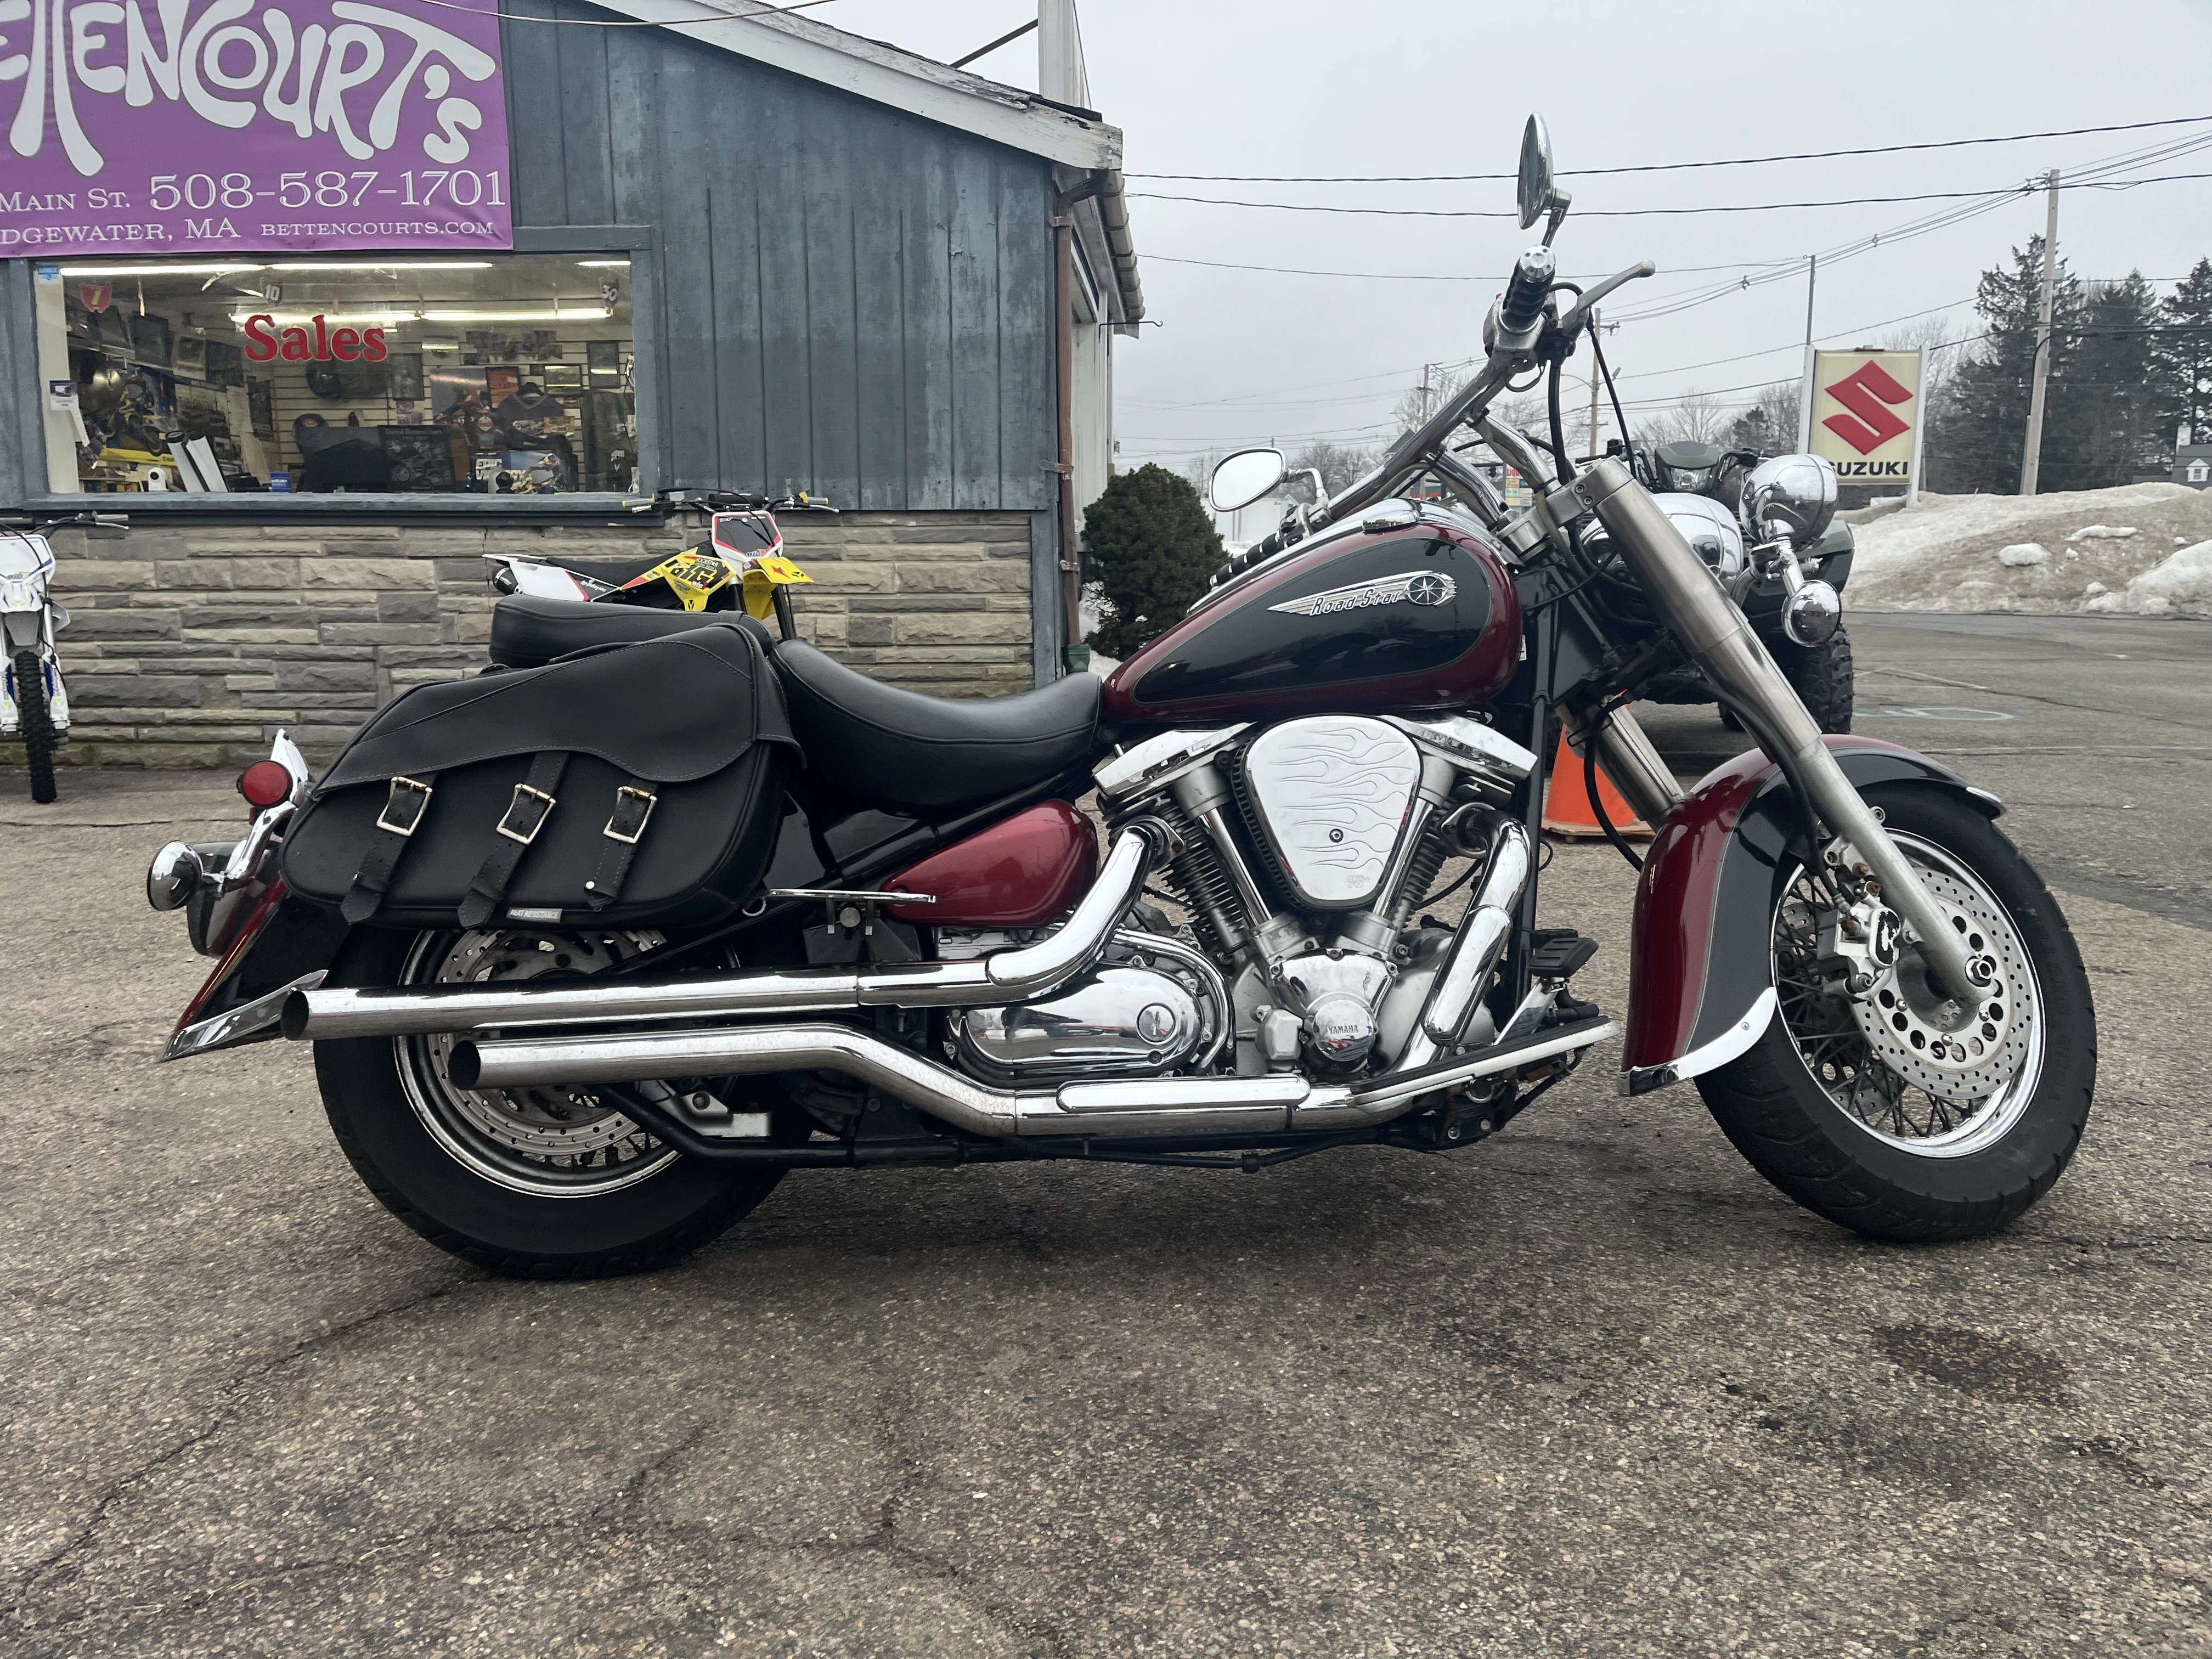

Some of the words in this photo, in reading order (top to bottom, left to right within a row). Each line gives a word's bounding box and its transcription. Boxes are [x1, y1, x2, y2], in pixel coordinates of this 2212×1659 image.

[150, 170, 506, 210] 508-587-1701
[184, 217, 241, 239] MA
[261, 222, 494, 236] BETTENCOURTS.COM
[265, 284, 280, 301] 10
[601, 284, 618, 301] 30
[244, 314, 387, 362] Sales
[1309, 595, 1355, 616] Road
[1359, 588, 1402, 608] Star
[524, 910, 559, 919] RESISTANCE
[1327, 1025, 1359, 1035] YAMAHA
